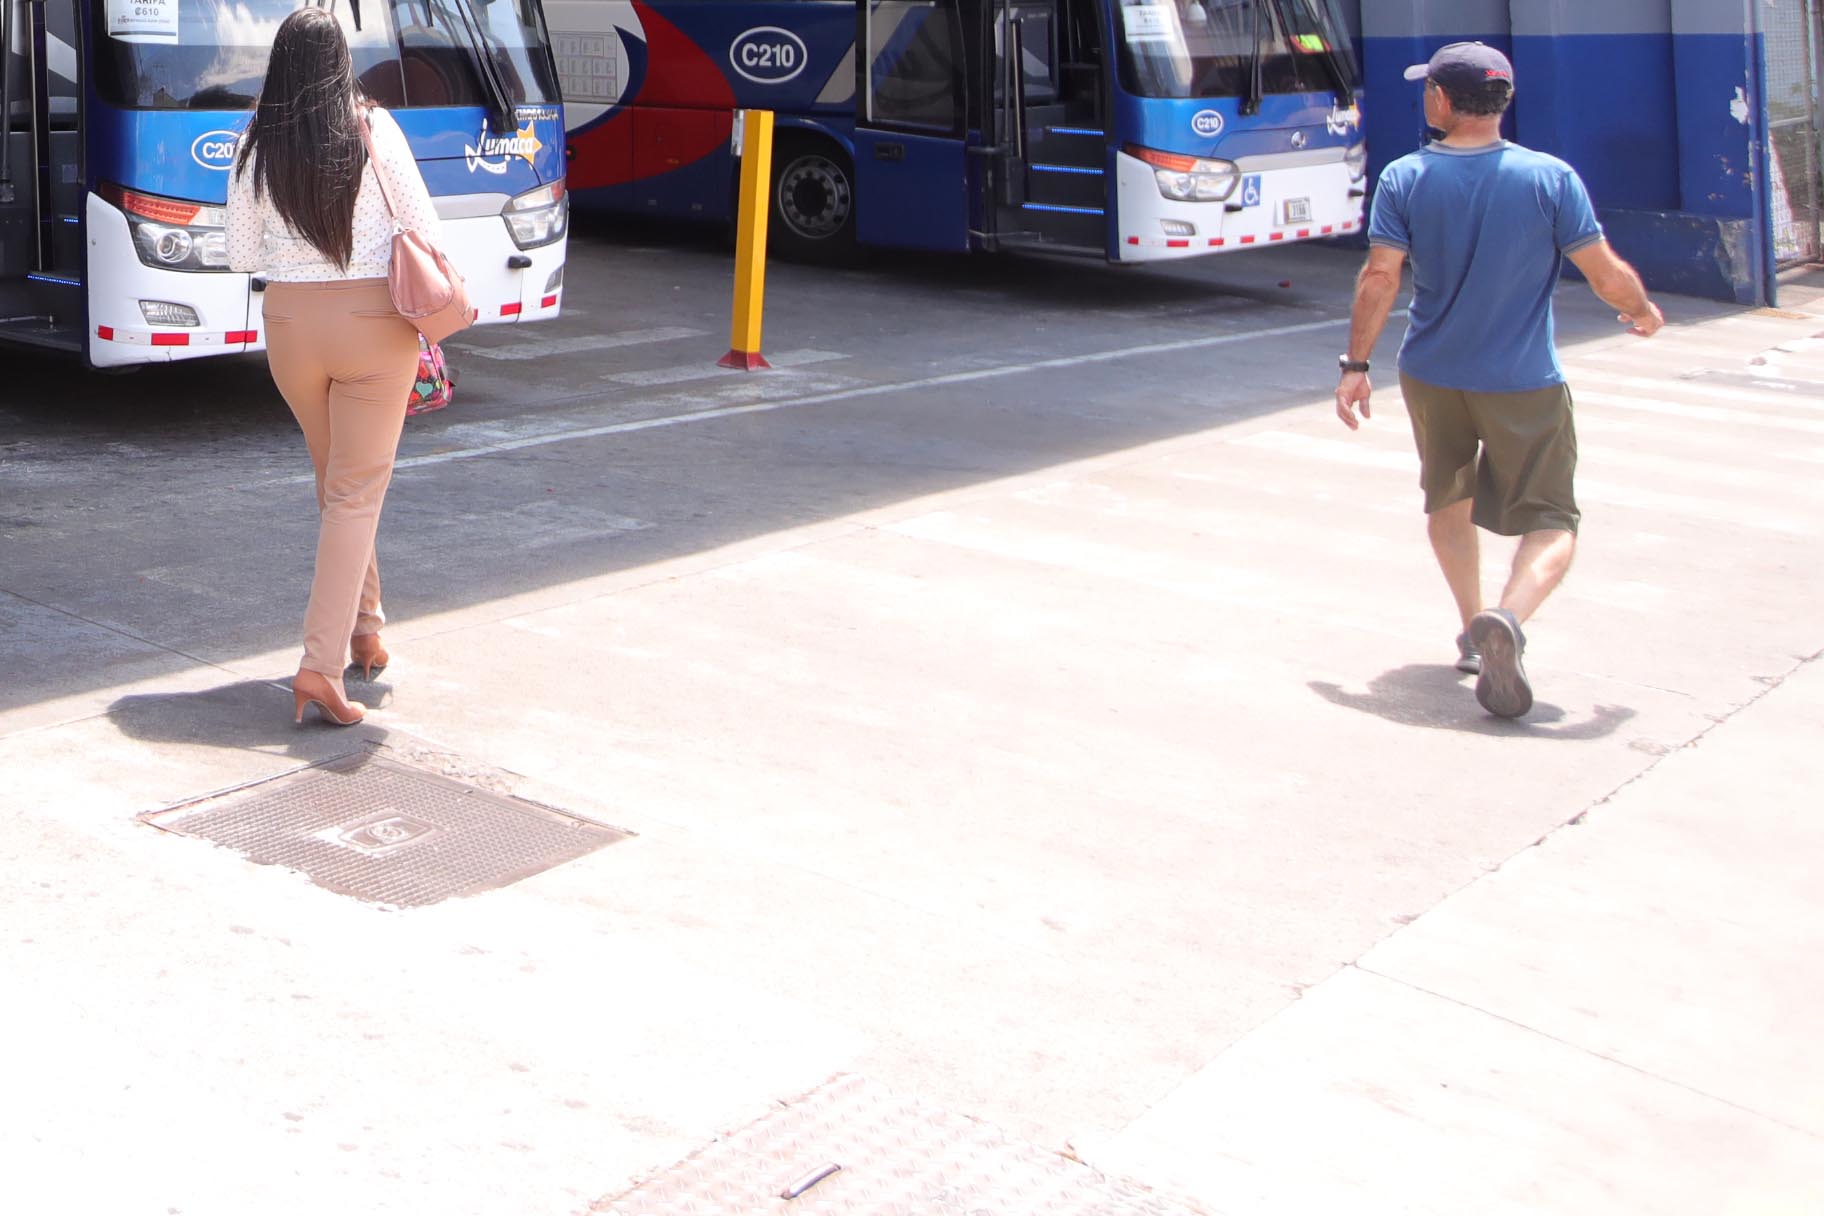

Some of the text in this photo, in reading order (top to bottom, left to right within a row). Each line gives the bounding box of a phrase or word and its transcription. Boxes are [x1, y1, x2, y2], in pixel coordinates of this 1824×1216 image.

[742, 42, 795, 67] C210
[1196, 117, 1219, 130] C210
[202, 142, 236, 159] C20
